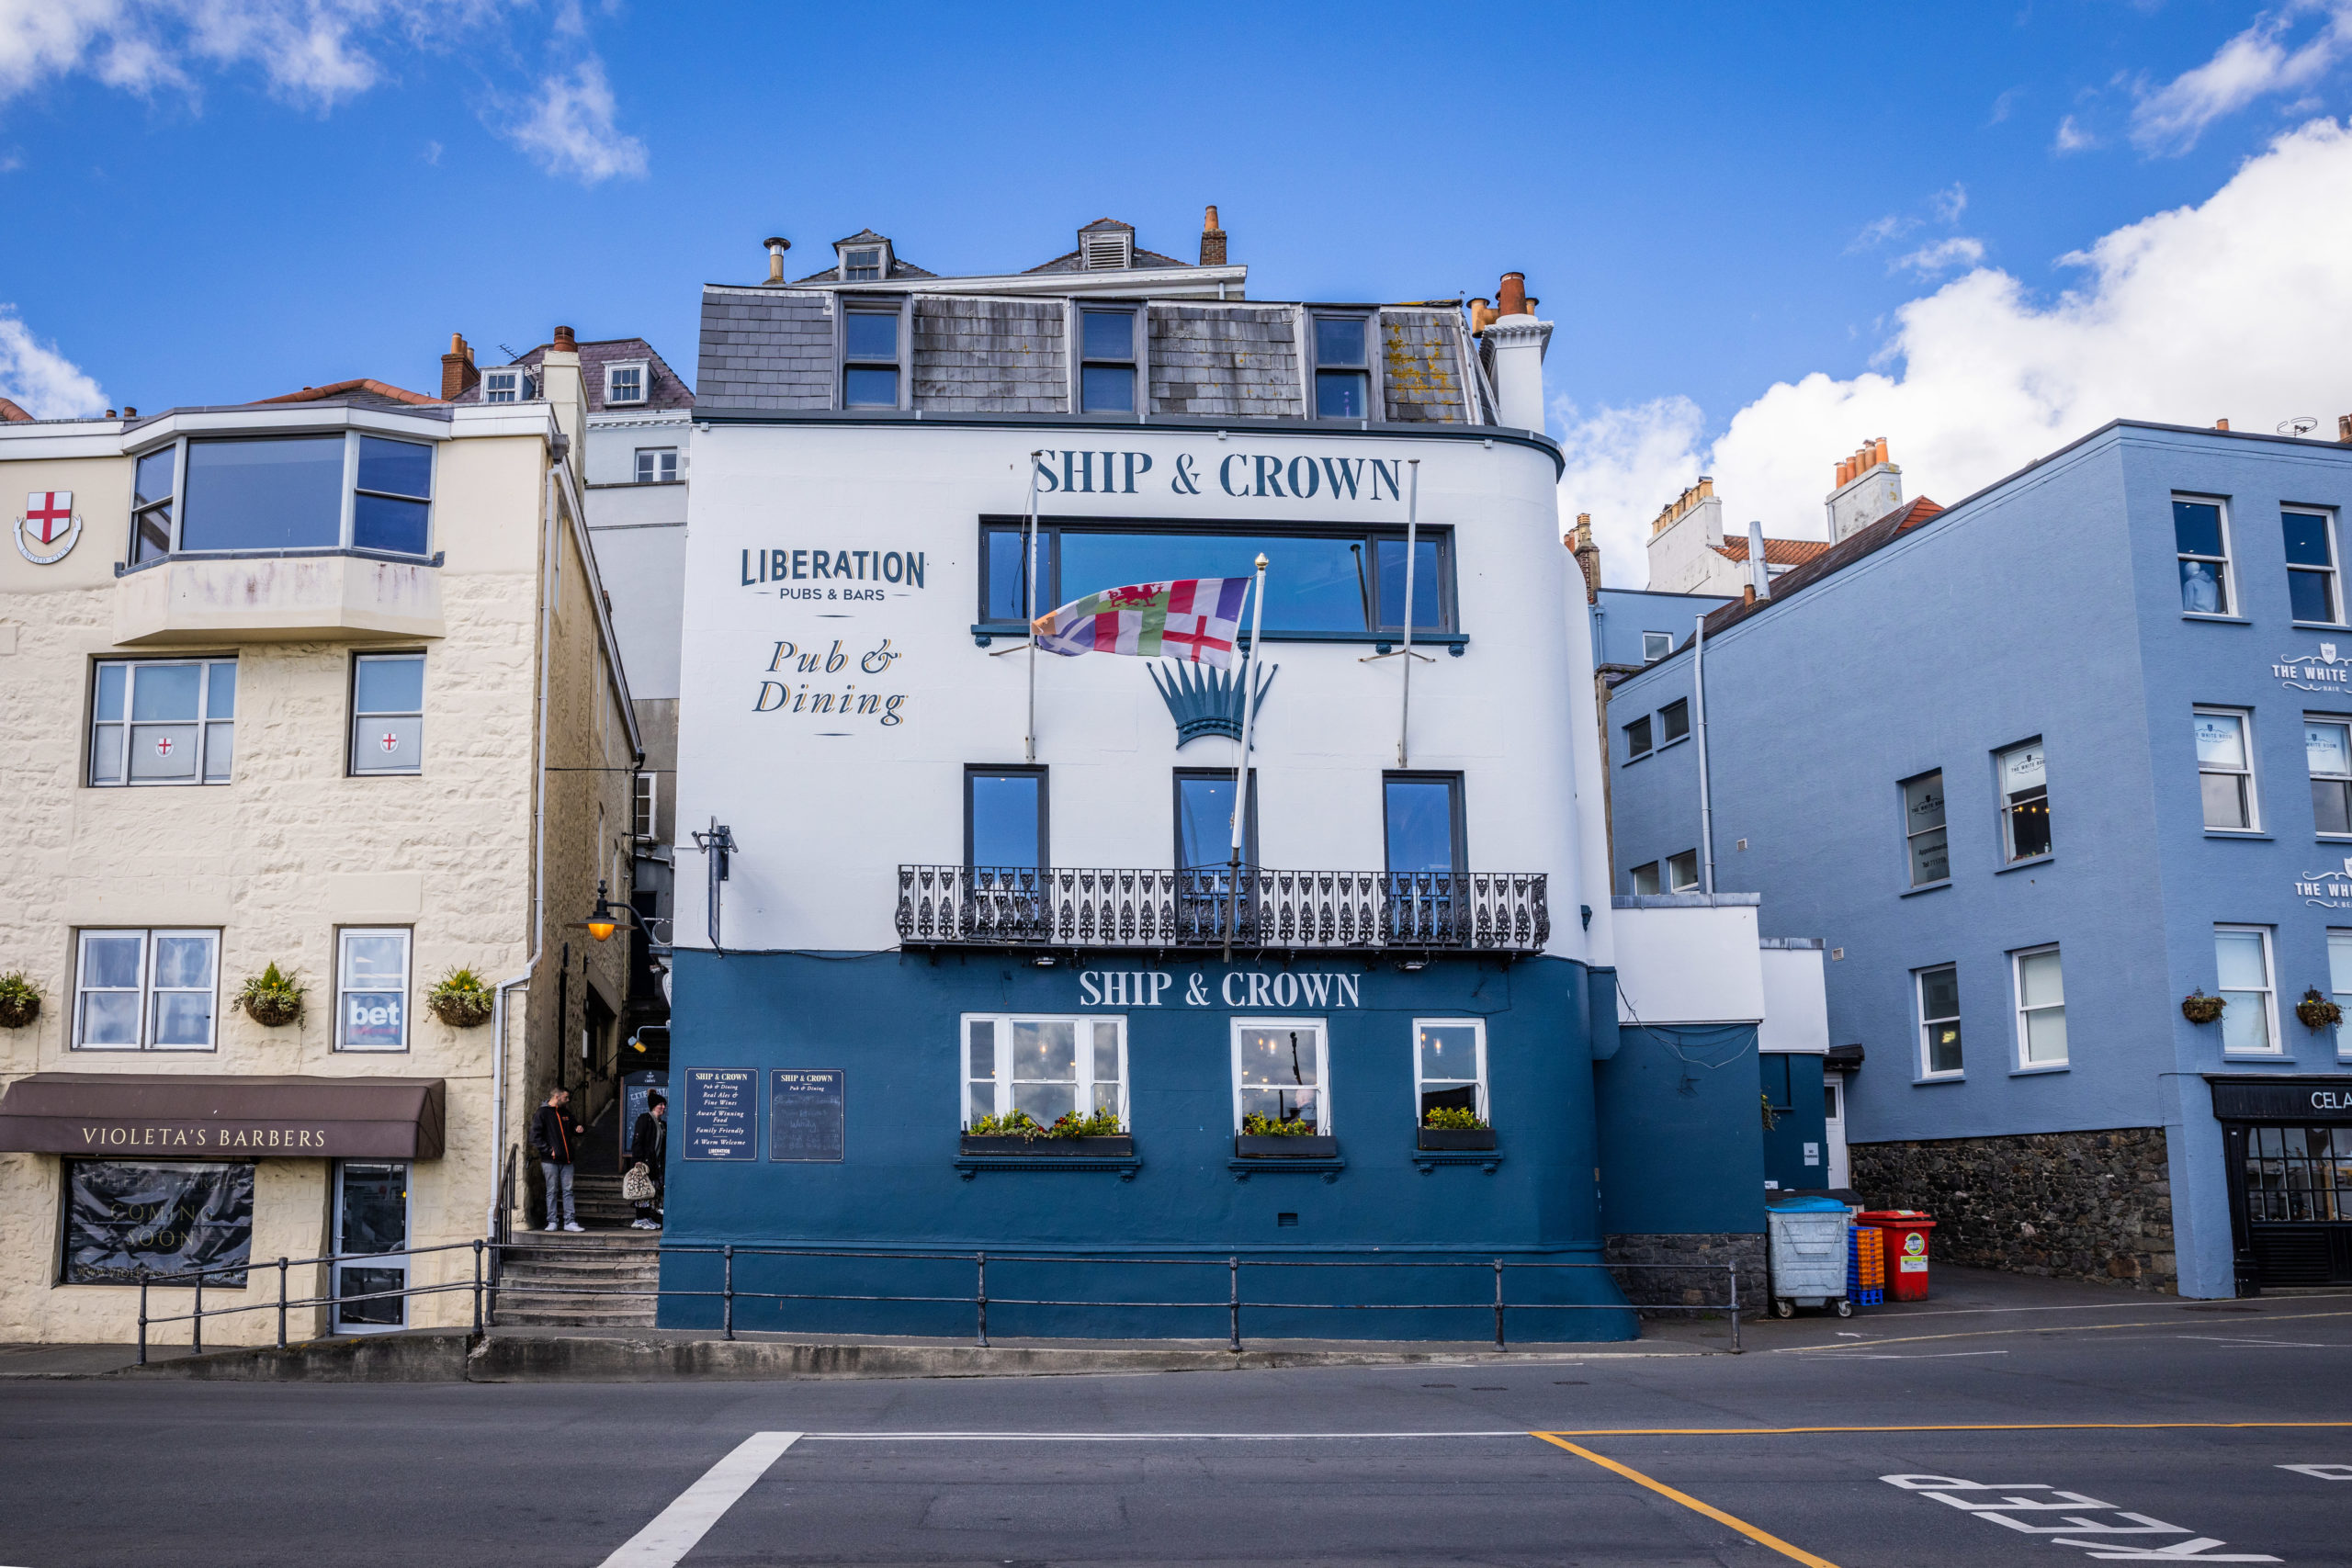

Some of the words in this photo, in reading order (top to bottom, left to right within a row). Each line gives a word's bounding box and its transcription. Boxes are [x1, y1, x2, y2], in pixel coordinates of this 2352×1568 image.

[1034, 449, 1153, 494] SHIP
[1171, 453, 1202, 495] &
[1219, 454, 1403, 502] CROWN
[21, 547, 47, 563] UNITED
[741, 548, 925, 590] LIBERATION
[780, 588, 822, 600] PUBS
[827, 588, 838, 600] &
[843, 589, 886, 601] BARS
[765, 639, 849, 673] Pub
[860, 638, 902, 674] &
[2271, 665, 2298, 679] THE
[2303, 666, 2348, 682] WHITE
[752, 681, 908, 727] Dining
[2294, 882, 2322, 897] THE
[1080, 971, 1172, 1006] SHIP
[1185, 972, 1211, 1007] &
[1222, 972, 1362, 1008] CROWN
[350, 1000, 400, 1025] bet
[721, 1073, 748, 1081] CROWN
[781, 1074, 798, 1082] SHIP
[82, 1127, 207, 1146] VIOLETA'S
[219, 1129, 326, 1147] BARBERS
[110, 1203, 214, 1222] COMING
[126, 1229, 194, 1247] SOON
[1878, 1473, 2286, 1562] KEEP
